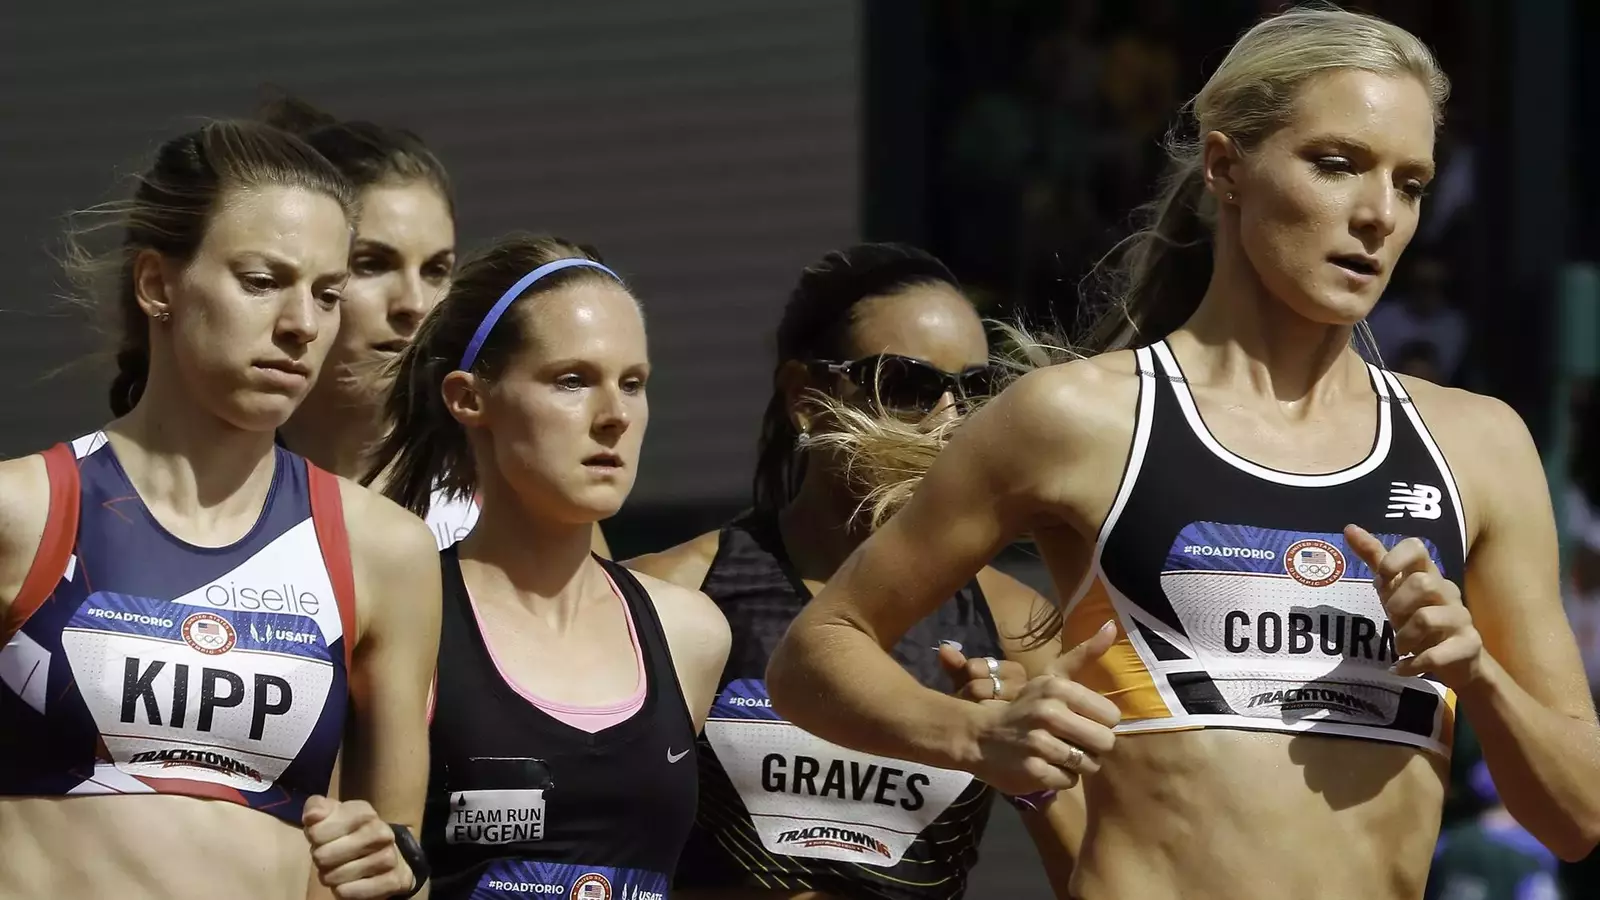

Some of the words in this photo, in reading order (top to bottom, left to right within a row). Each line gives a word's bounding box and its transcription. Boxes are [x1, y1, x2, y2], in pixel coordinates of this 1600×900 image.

[1184, 545, 1275, 561] #ROADTORIO
[205, 581, 319, 616] oiselle
[87, 608, 174, 628] #ROADTORIO
[275, 630, 317, 645] USATF
[119, 656, 294, 741] KIPP
[761, 753, 931, 811] GRAVES
[454, 809, 502, 824] TEAM
[507, 808, 541, 822] RUN
[454, 823, 541, 842] EUGENE
[488, 880, 565, 895] #ROADTORIO
